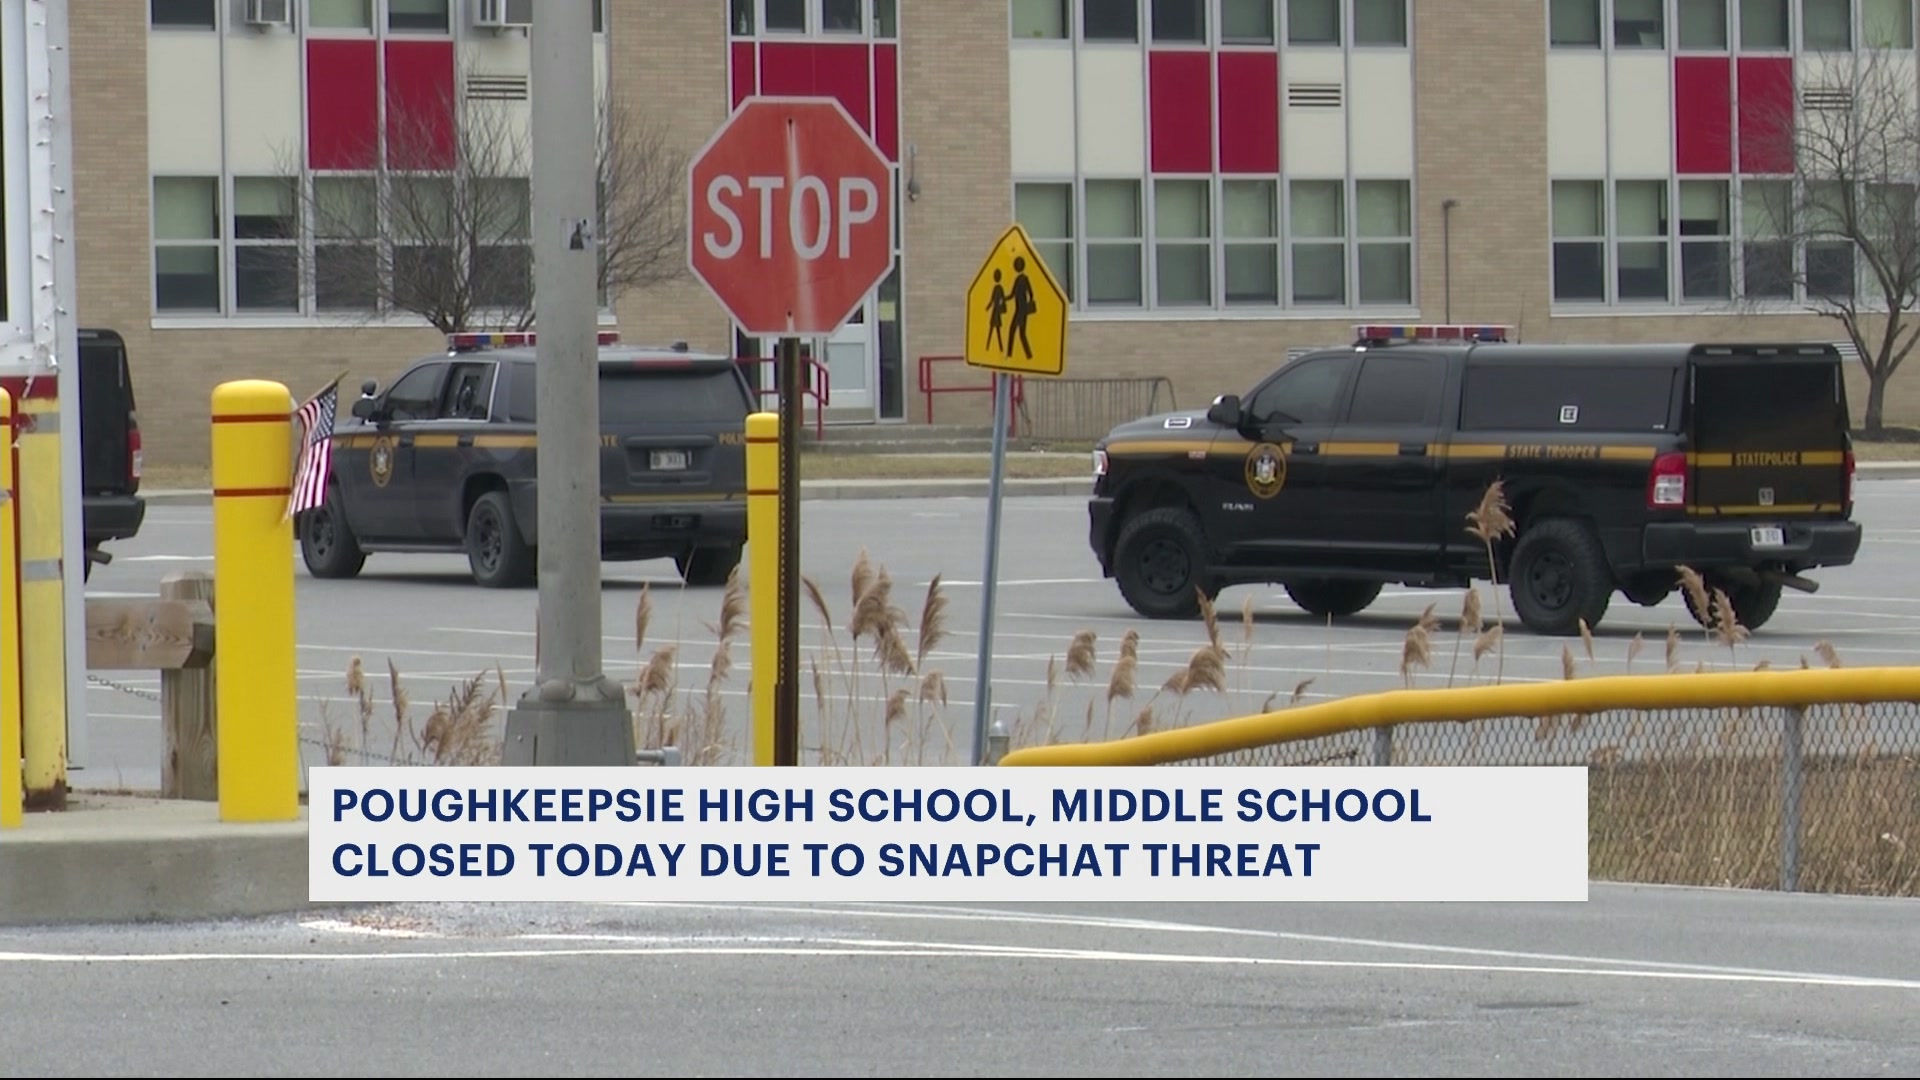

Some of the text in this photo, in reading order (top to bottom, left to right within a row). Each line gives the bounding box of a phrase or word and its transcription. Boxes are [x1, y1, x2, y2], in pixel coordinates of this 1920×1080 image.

[703, 175, 879, 261] STOP
[1509, 444, 1597, 459] STATE TROOPER
